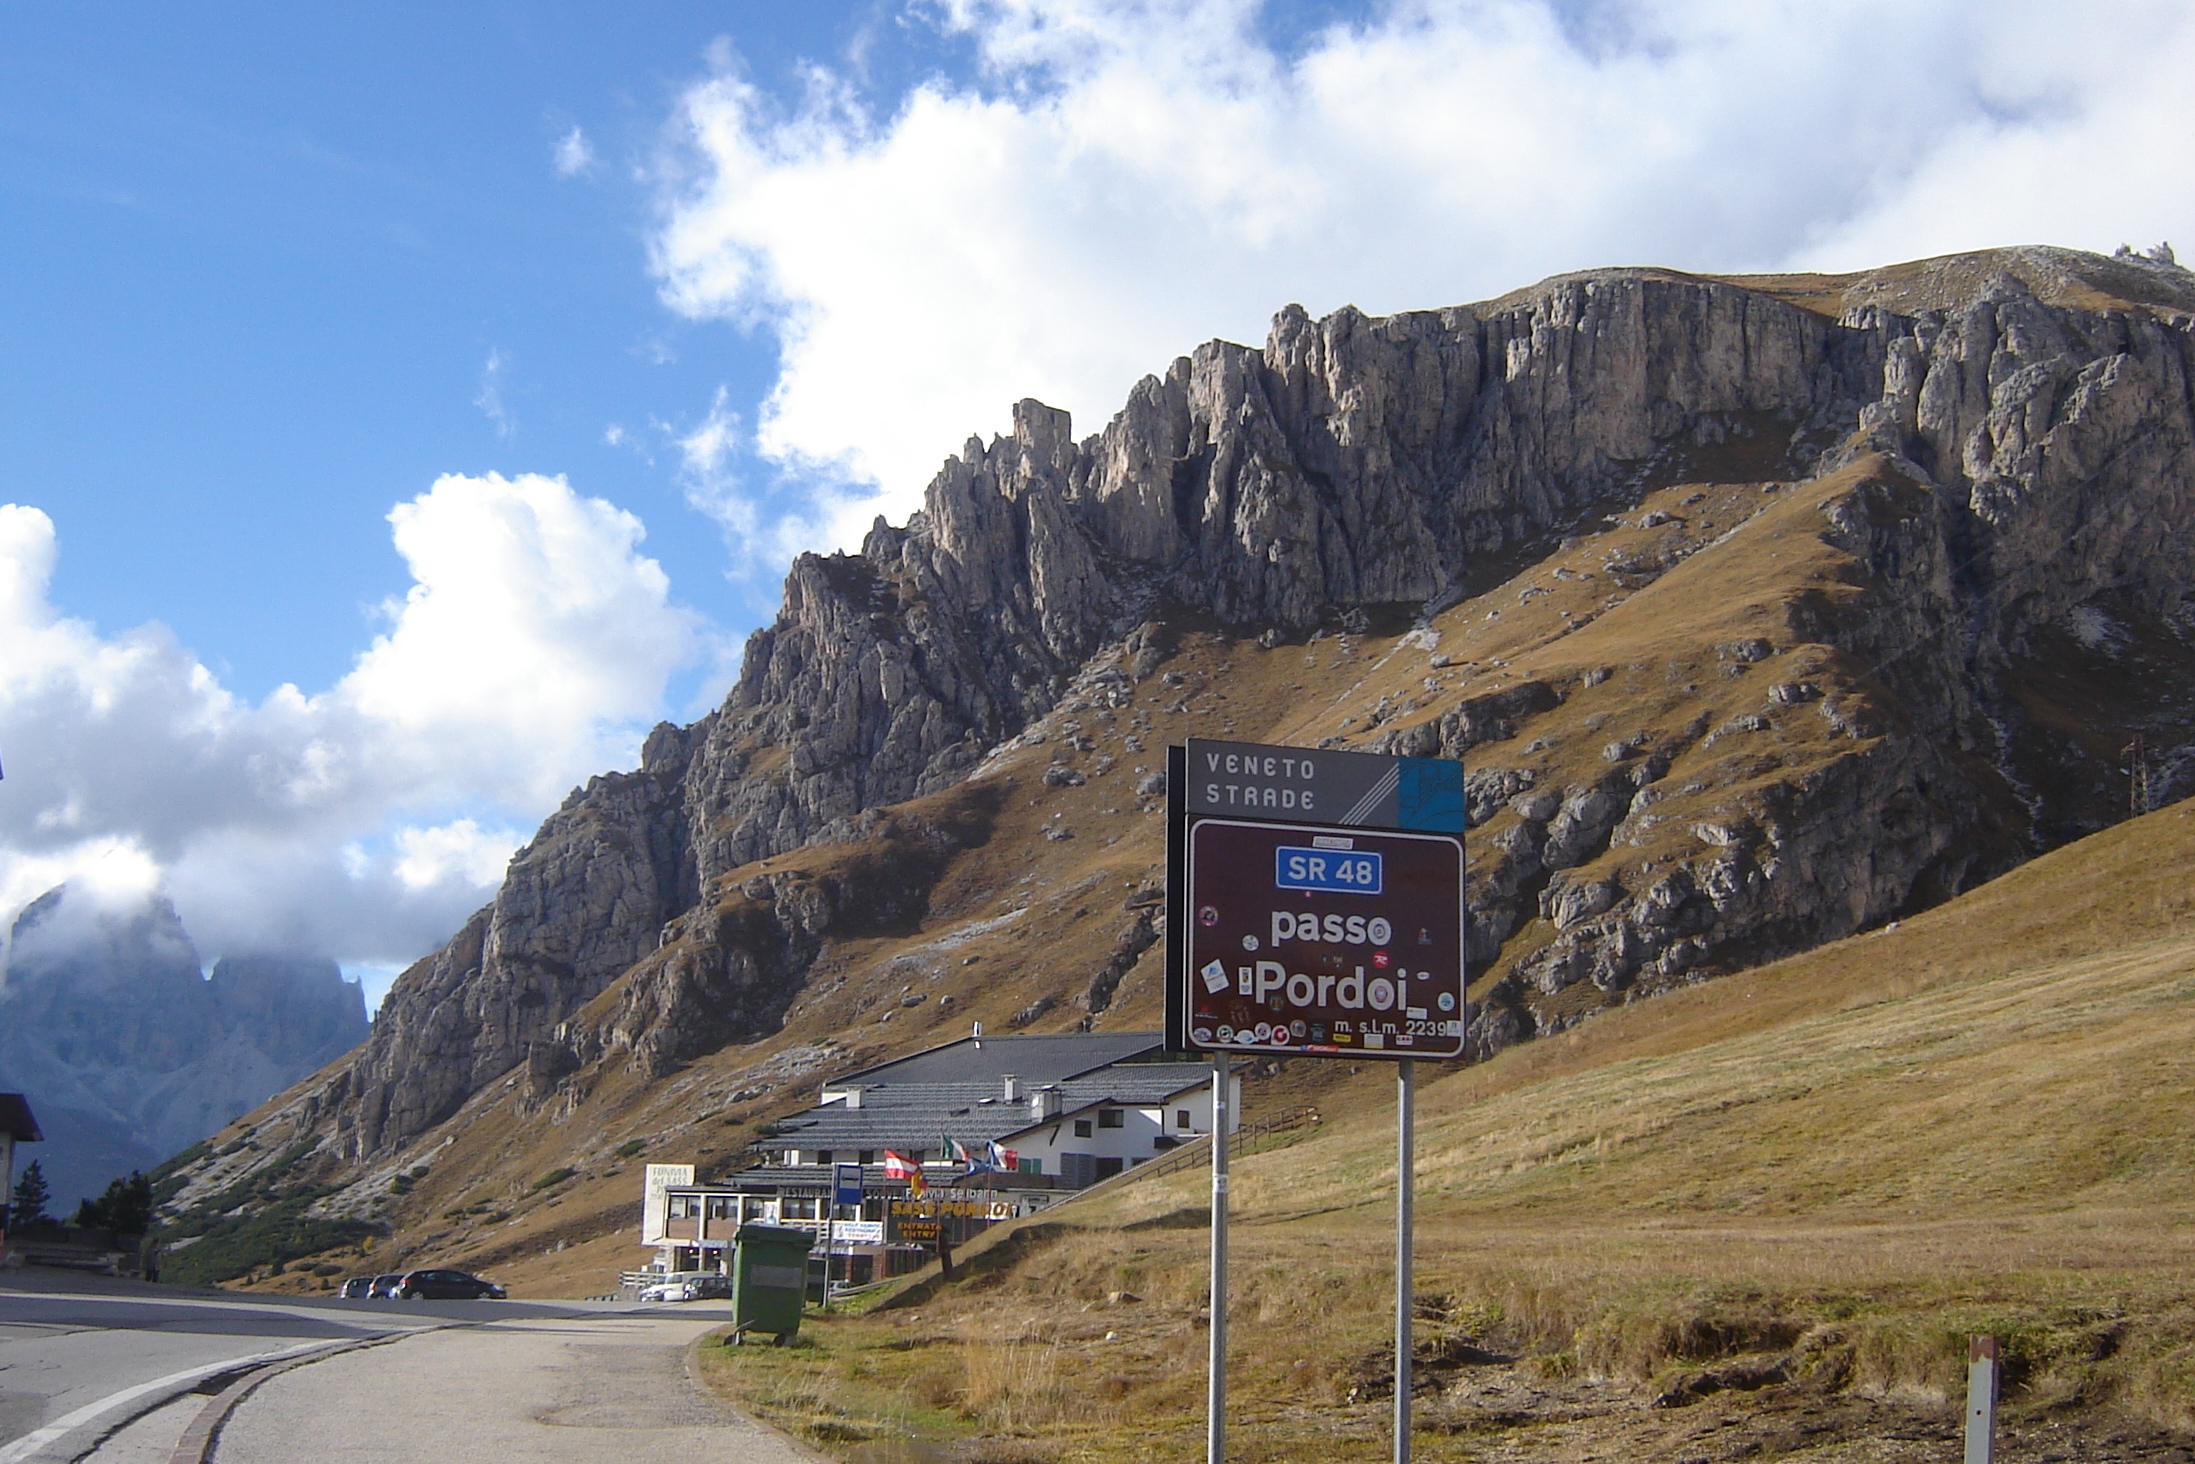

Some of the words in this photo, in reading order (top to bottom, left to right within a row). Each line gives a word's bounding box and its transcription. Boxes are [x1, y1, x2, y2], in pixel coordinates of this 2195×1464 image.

[1206, 752, 1314, 779] VENETO
[1206, 783, 1314, 810] STRADE
[1288, 856, 1326, 881] SR
[1335, 860, 1372, 885] 48
[1271, 910, 1392, 947] passo
[1255, 960, 1407, 1011] Pordoi
[1405, 1020, 1447, 1036] 2239
[891, 1201, 935, 1216] SASS
